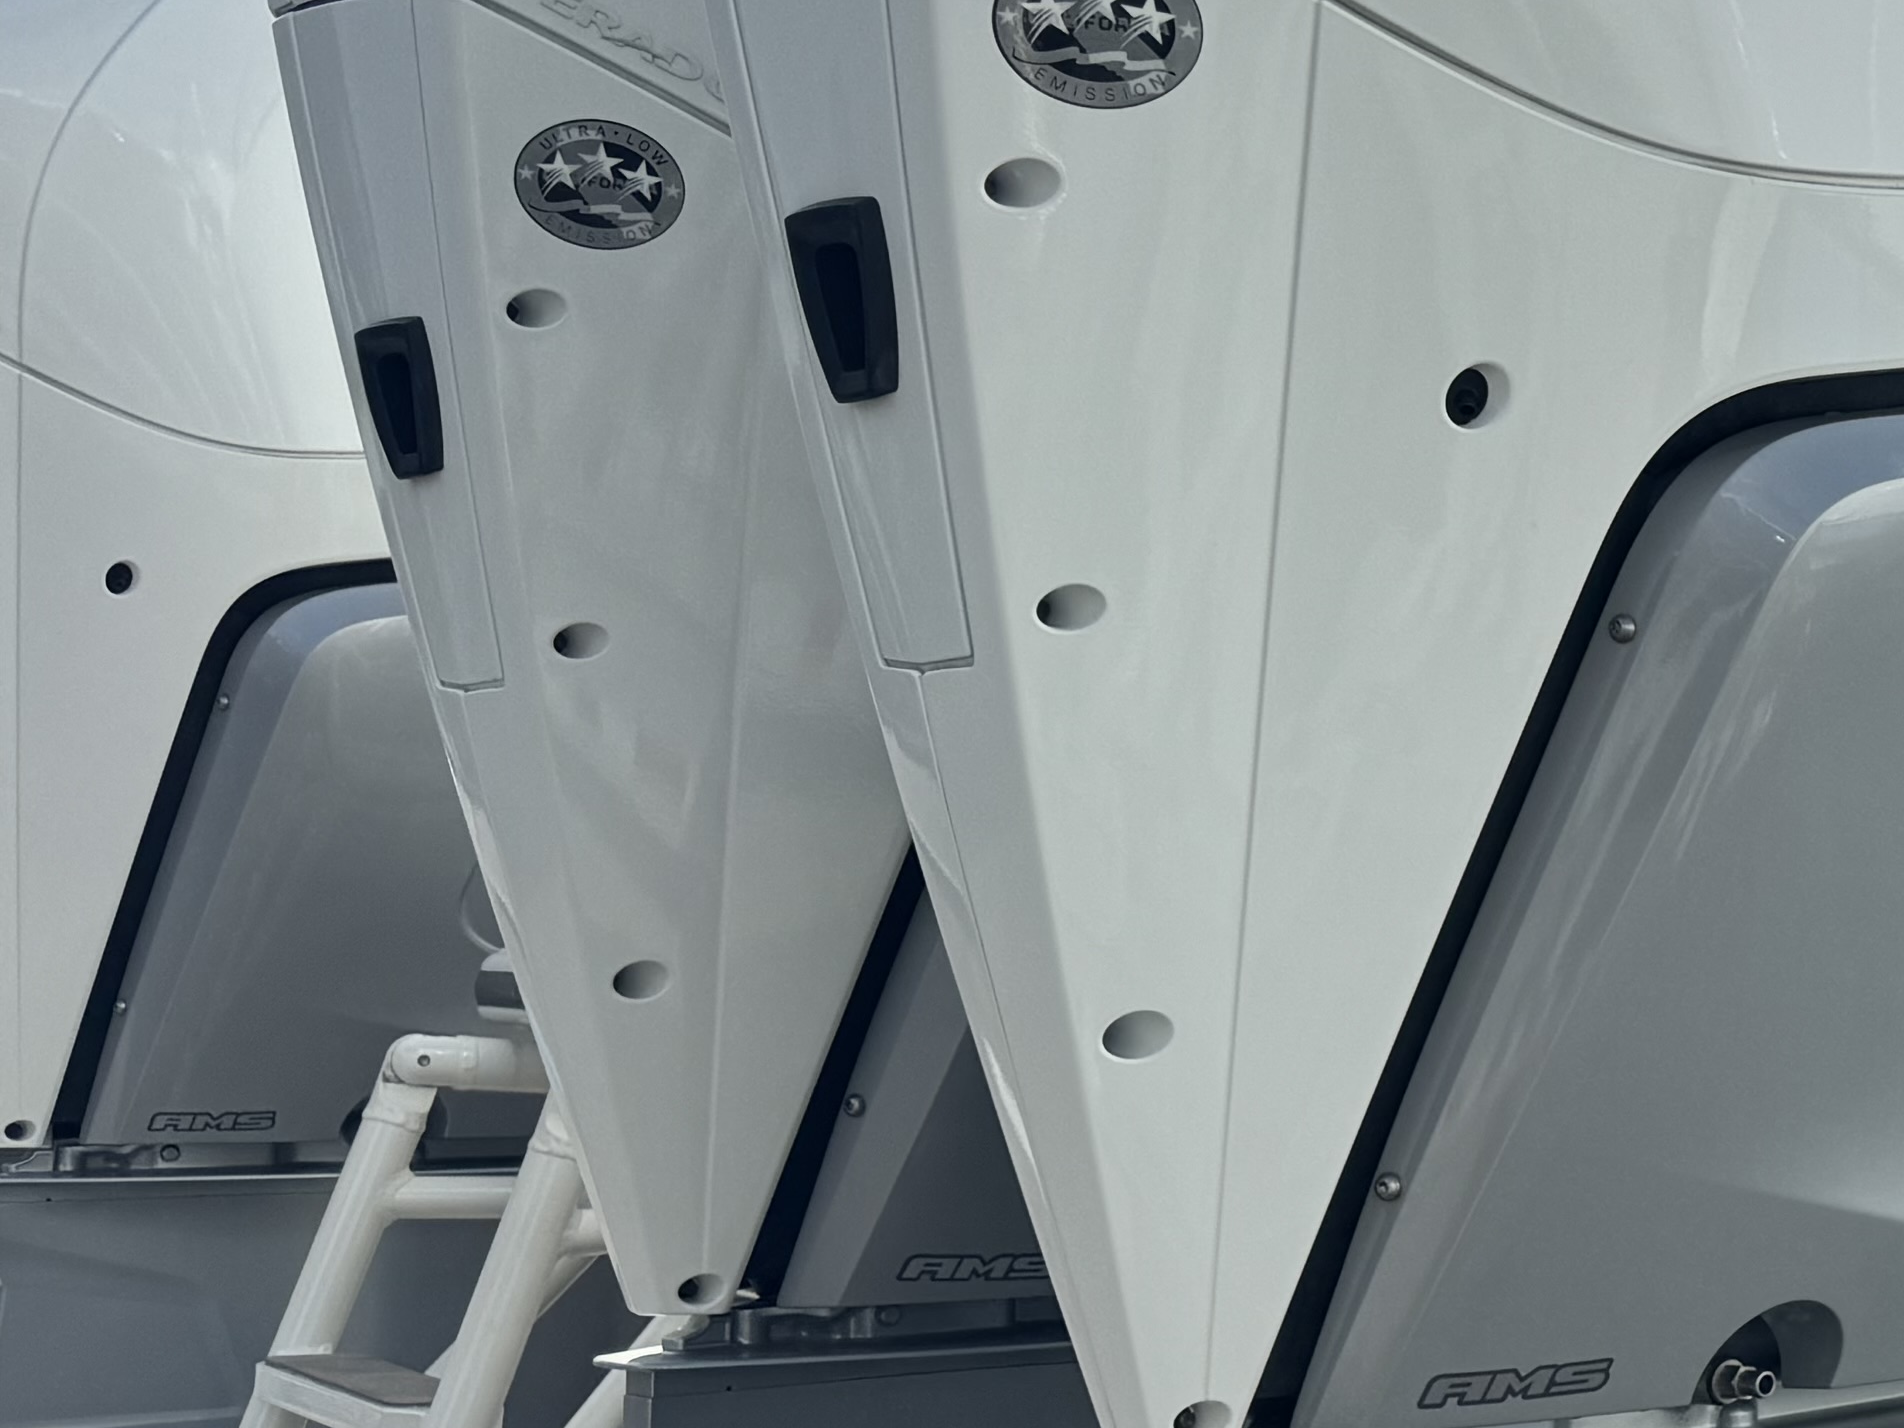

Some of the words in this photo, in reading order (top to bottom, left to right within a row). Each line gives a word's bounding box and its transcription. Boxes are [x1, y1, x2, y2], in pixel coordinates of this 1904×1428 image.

[1034, 68, 1166, 101] EMISSION
[539, 125, 606, 150] ULTRA
[626, 134, 669, 165] LOW
[147, 1110, 276, 1131] AMS
[897, 1253, 1051, 1281] AMS
[1417, 1358, 1614, 1409] AMS
